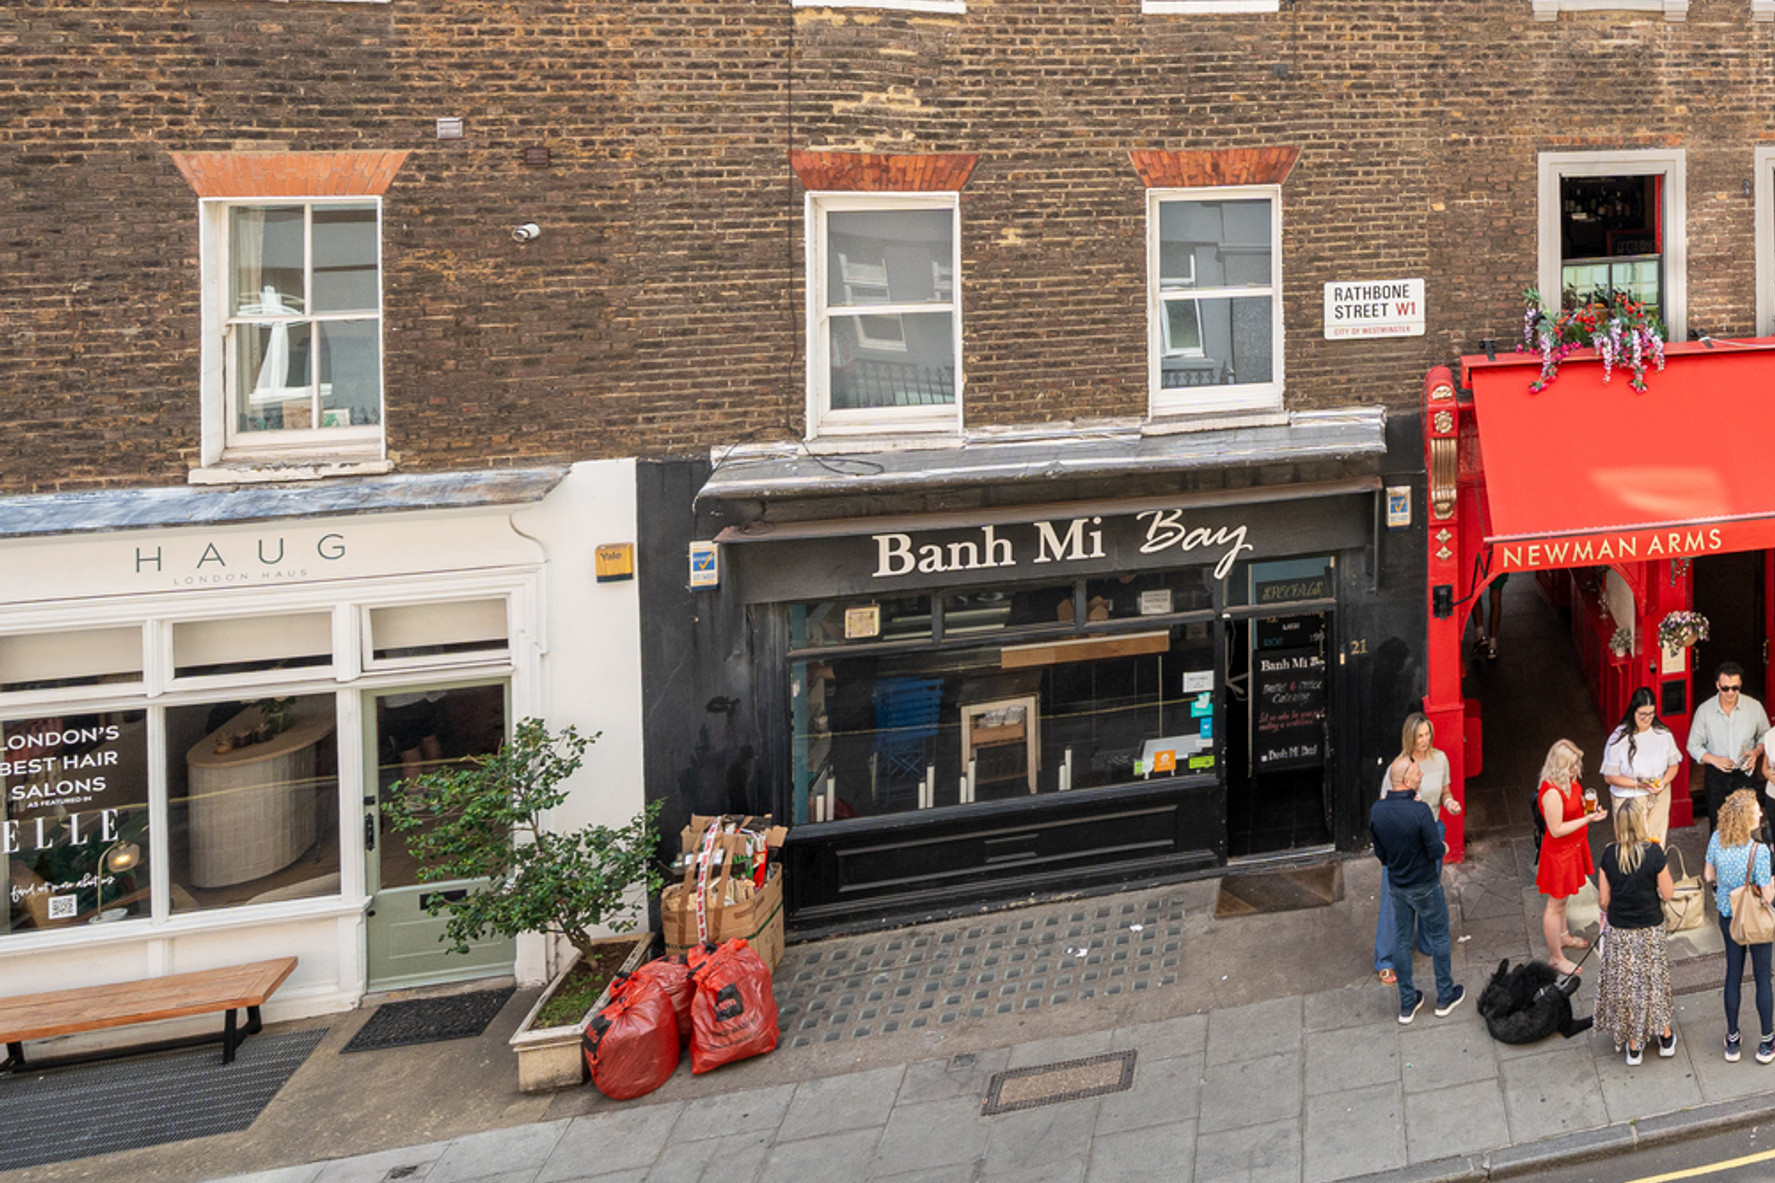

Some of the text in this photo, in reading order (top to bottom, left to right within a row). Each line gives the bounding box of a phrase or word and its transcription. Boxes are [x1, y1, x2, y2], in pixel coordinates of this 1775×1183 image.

[1334, 283, 1410, 302] RATHBONE
[1334, 301, 1416, 320] STREET W1
[1333, 325, 1411, 336] CITY OF WESTMINSTER
[135, 533, 346, 573] HAUG
[871, 508, 1253, 580] Banh Mi Bay
[1503, 528, 1723, 568] NEWMAN ARMS
[600, 550, 622, 561] Yale
[174, 568, 308, 586] LONDON HAUS
[1262, 580, 1324, 601] SPECIALS
[1351, 639, 1368, 655] 21
[1261, 658, 1289, 672] Banh
[0, 750, 119, 776] BEST HAIR
[12, 776, 107, 801] SALONS
[2, 808, 119, 855] ELLE
